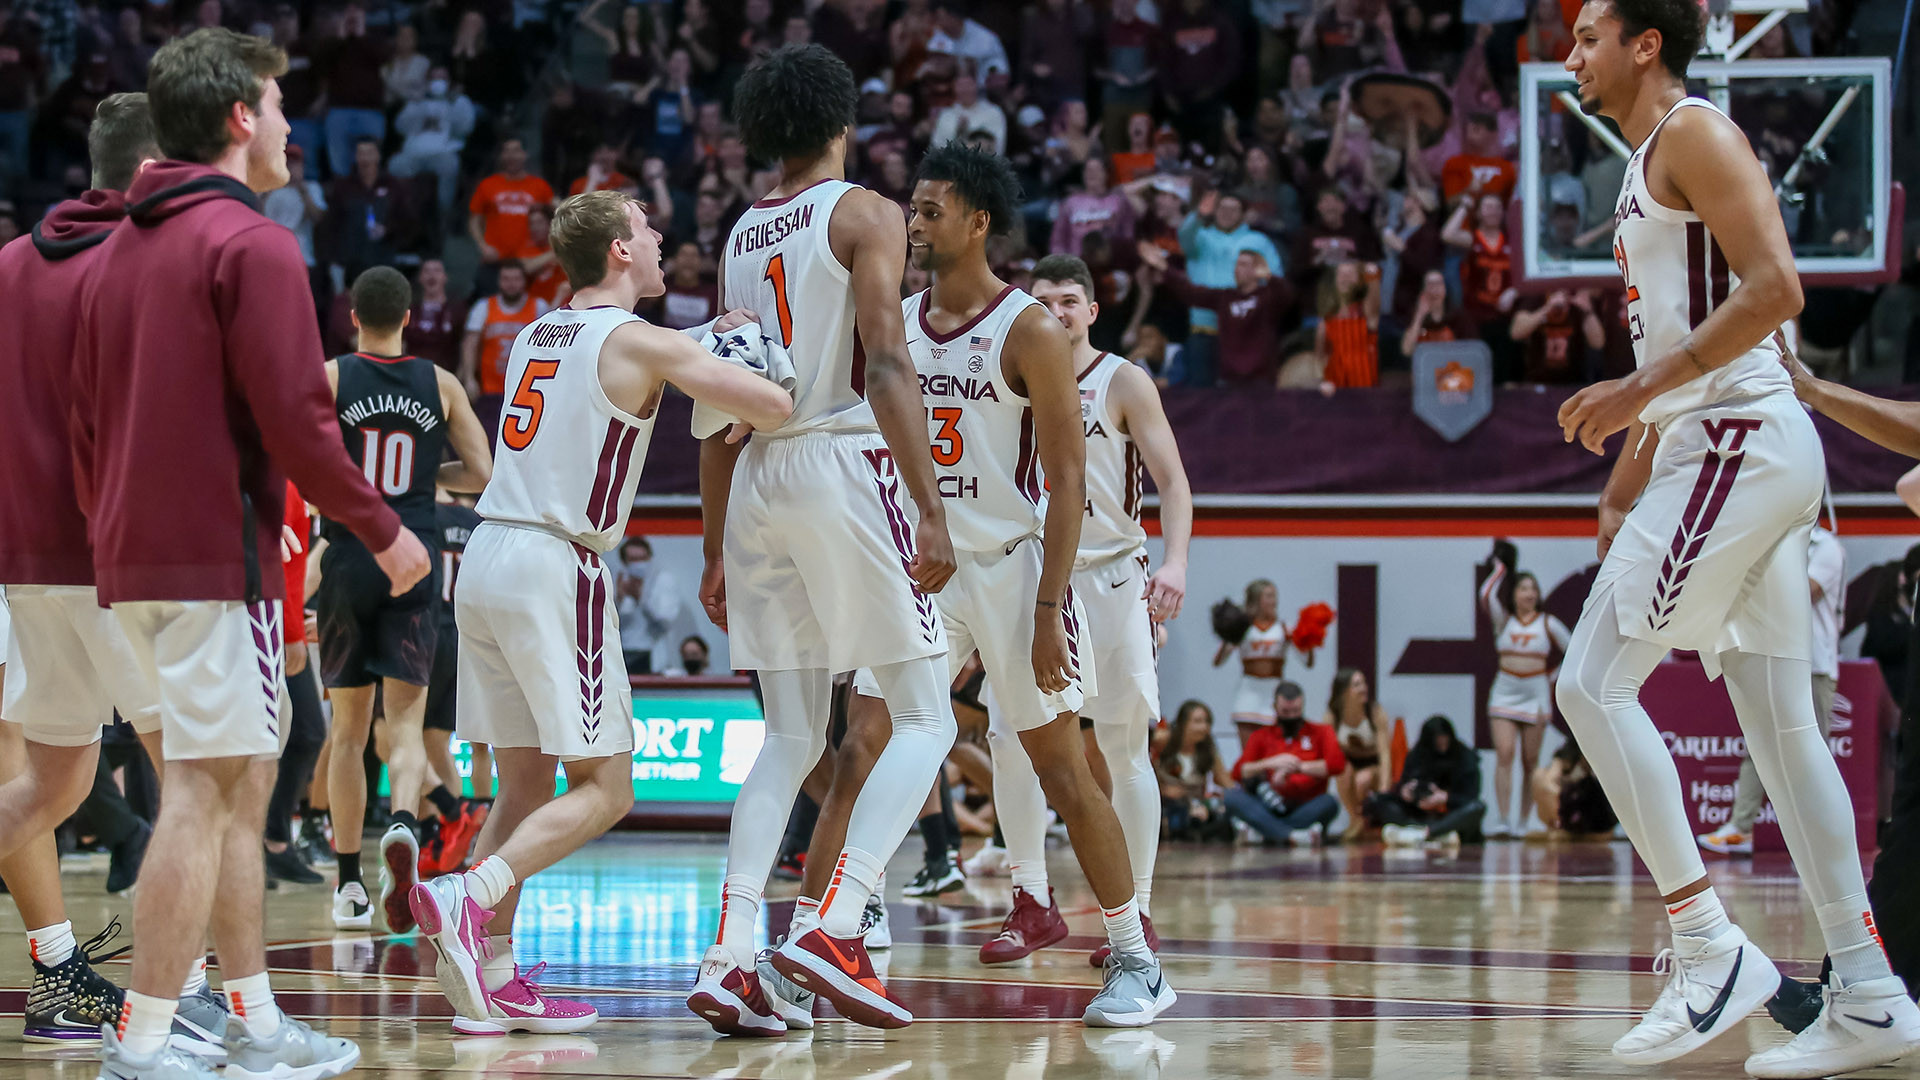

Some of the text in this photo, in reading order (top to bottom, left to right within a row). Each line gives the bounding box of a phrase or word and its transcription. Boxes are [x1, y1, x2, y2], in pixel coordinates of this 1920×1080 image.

[734, 203, 814, 258] N'GUESSAN
[763, 252, 793, 350] 1
[527, 322, 586, 348] MURPHY
[340, 393, 439, 433] WILLIAMSON
[502, 358, 560, 452] 5
[359, 427, 416, 496] 10
[925, 406, 964, 467] 3
